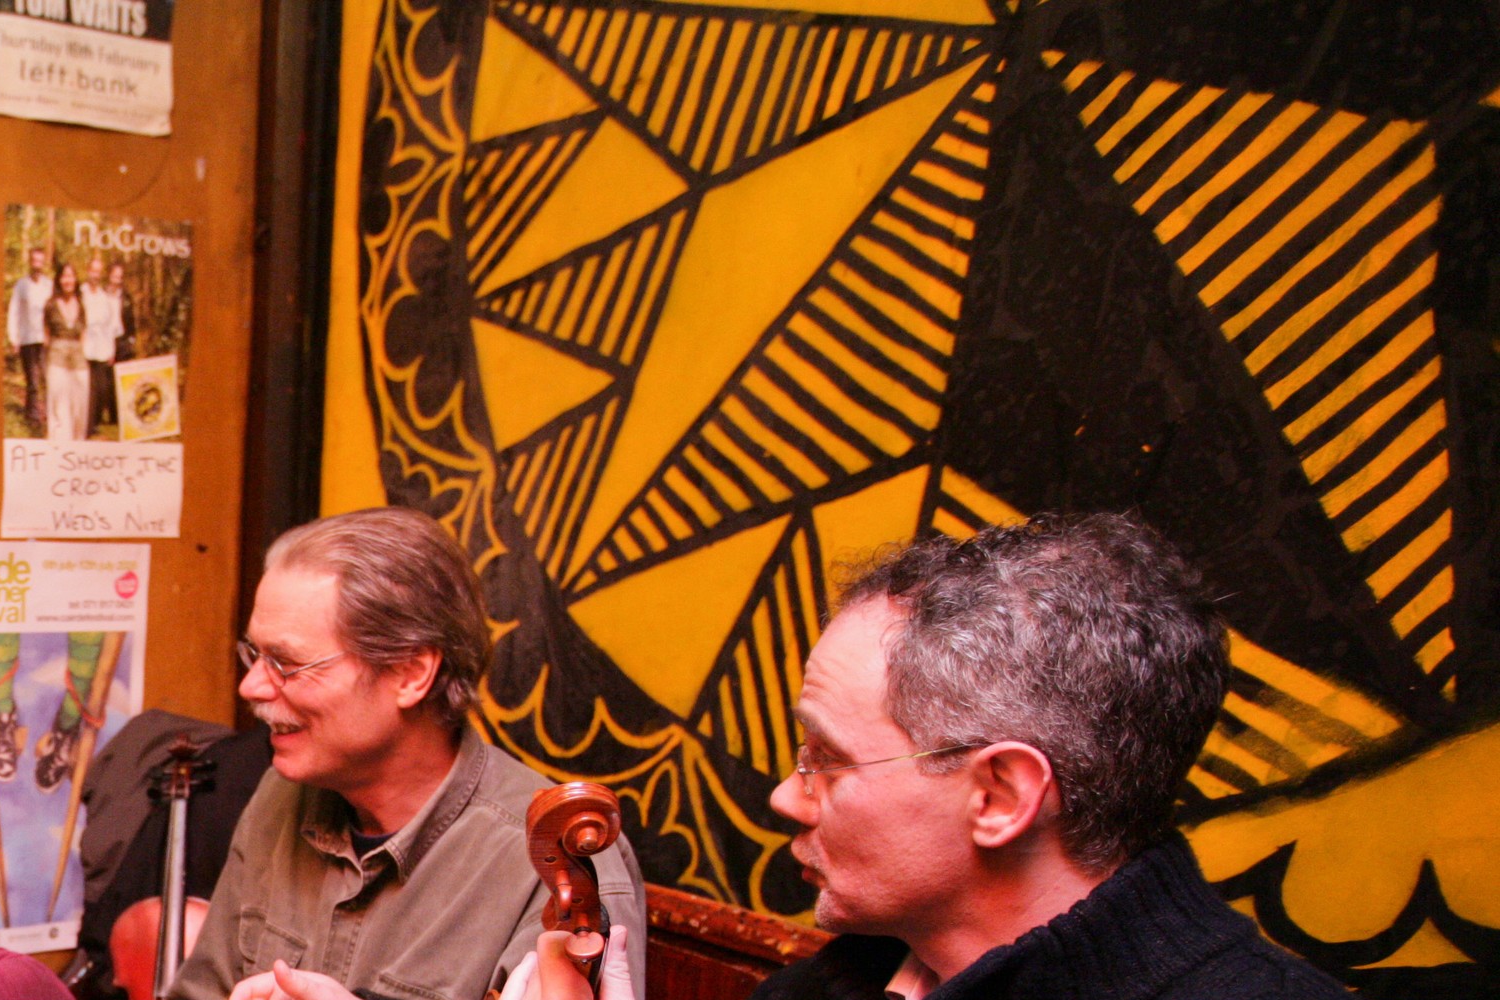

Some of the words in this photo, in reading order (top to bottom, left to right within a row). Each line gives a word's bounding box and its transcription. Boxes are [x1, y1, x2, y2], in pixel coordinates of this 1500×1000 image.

[71, 0, 147, 37] WAITS
[98, 45, 161, 75] February
[11, 445, 46, 472] AT
[137, 455, 178, 473] THE
